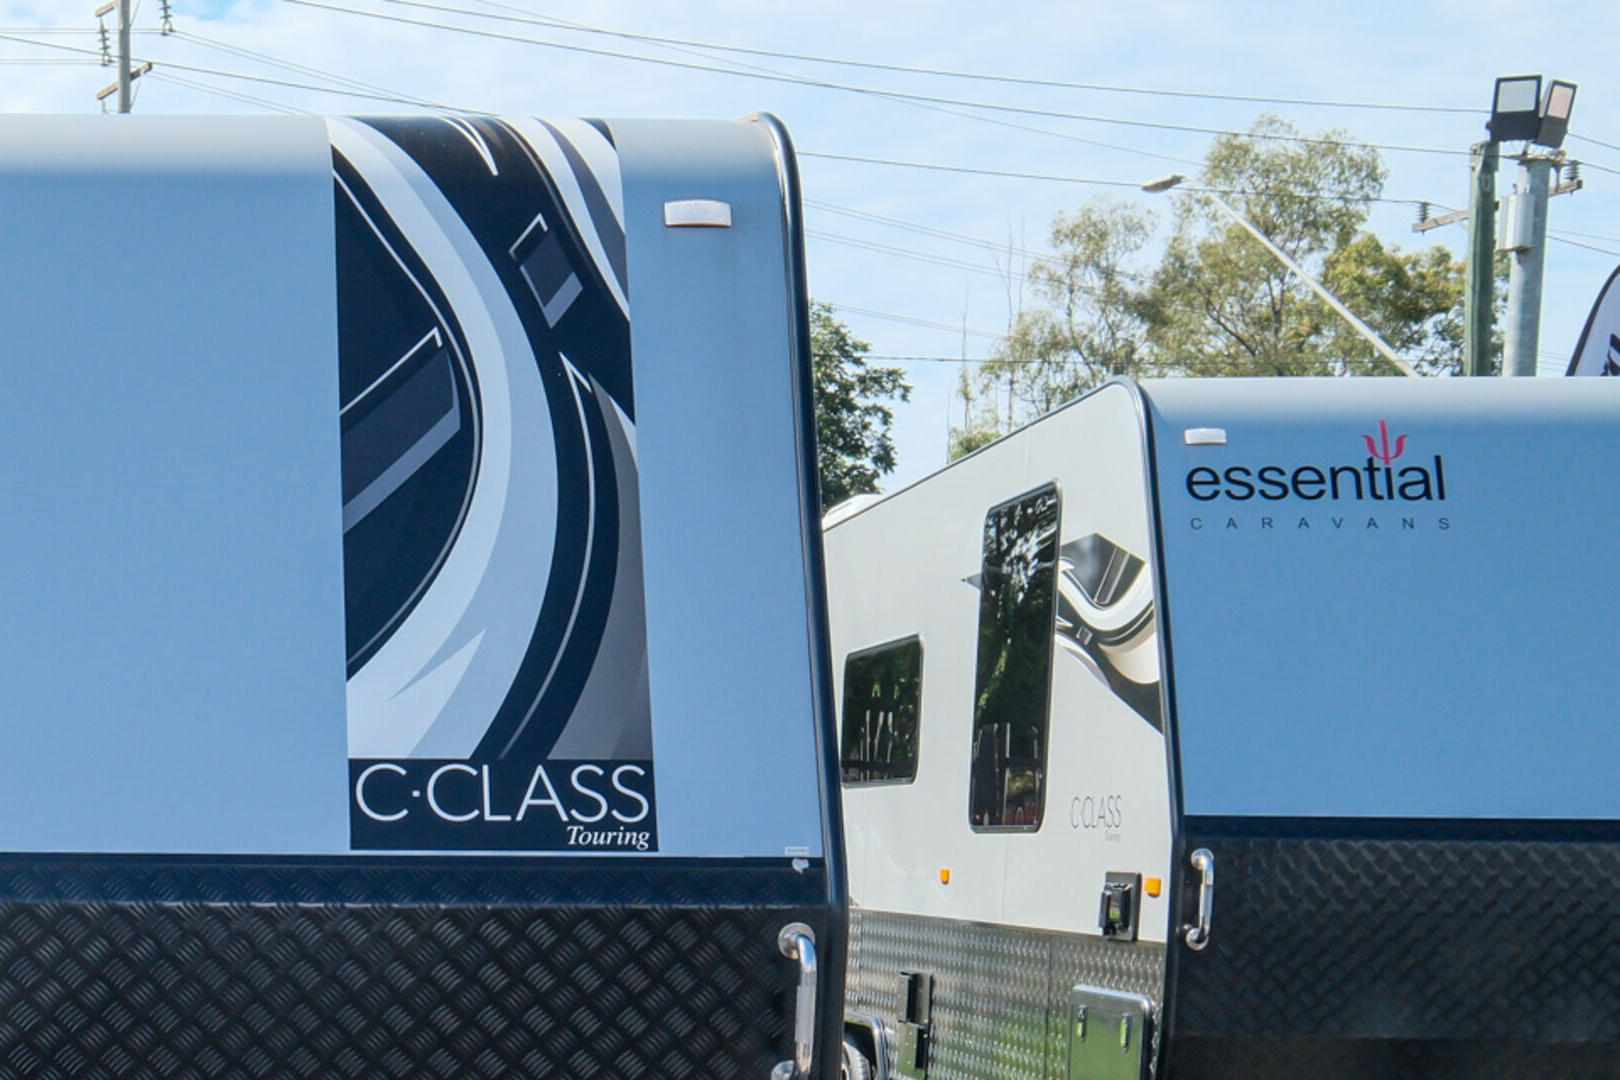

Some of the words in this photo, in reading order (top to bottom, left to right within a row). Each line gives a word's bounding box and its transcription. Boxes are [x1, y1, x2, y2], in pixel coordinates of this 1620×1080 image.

[1185, 455, 1446, 501] essential
[1190, 517, 1450, 531] CARAVANS
[567, 825, 650, 850] Touring
